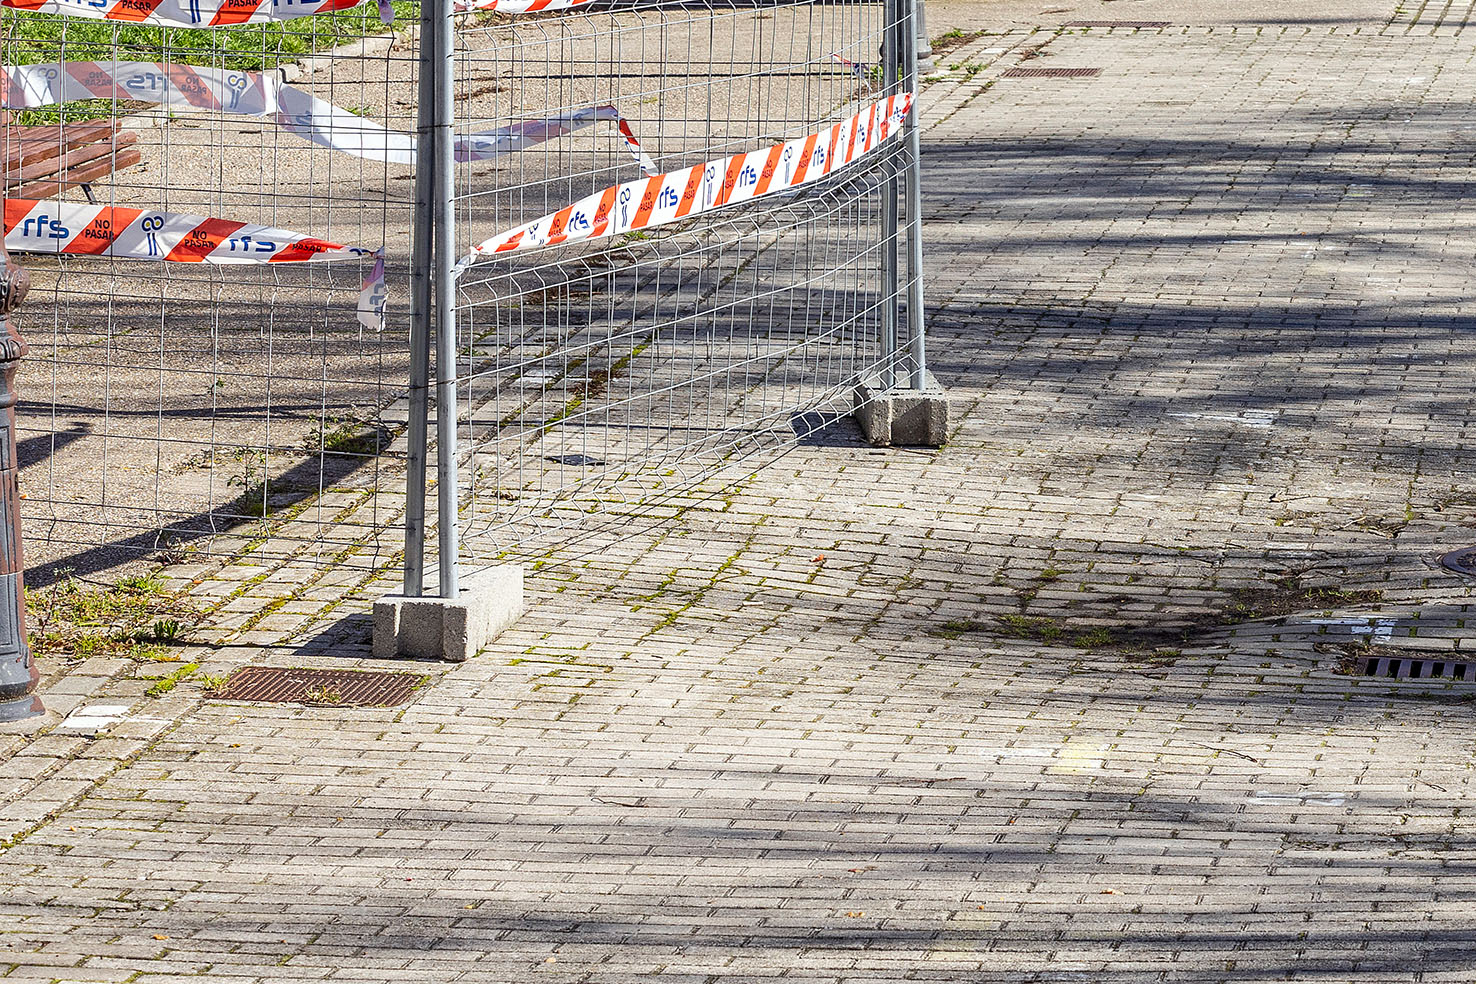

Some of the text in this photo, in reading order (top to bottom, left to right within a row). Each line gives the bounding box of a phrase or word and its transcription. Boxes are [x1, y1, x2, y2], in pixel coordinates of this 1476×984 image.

[121, 0, 152, 12] PASAR
[739, 165, 757, 188] rfs
[659, 186, 679, 209] rfs
[23, 214, 70, 239] rfs
[94, 219, 111, 230] NO
[192, 230, 208, 240] NO
[183, 238, 216, 250] PASAR
